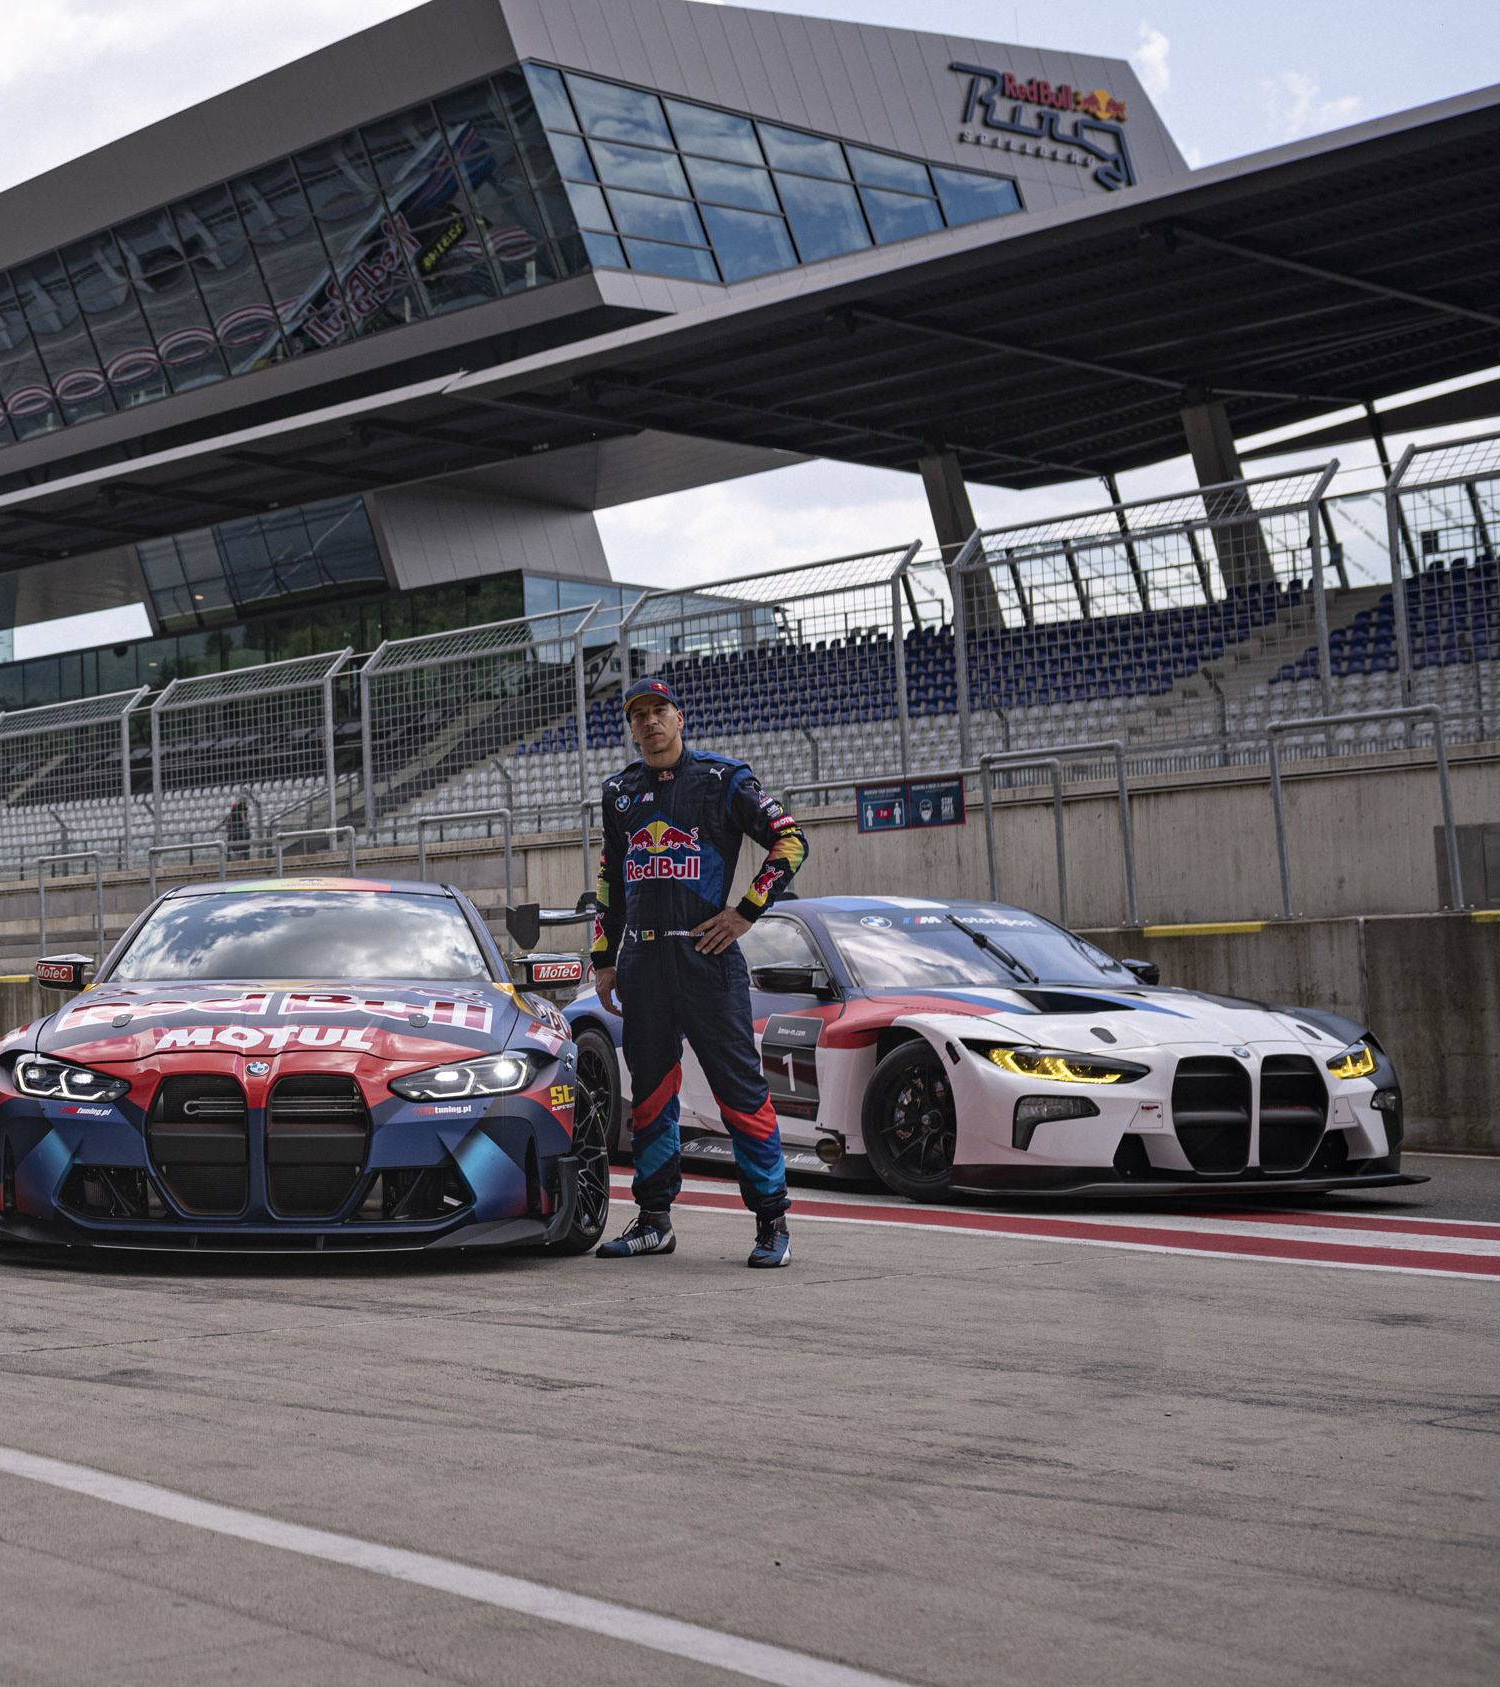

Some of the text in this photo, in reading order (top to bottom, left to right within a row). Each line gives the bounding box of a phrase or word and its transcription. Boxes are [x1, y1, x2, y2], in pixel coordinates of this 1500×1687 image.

[1003, 73, 1073, 110] Red Bull
[627, 856, 700, 882] Red Bull
[945, 916, 1037, 927] otorsport
[37, 965, 68, 979] MoTeC
[539, 965, 578, 979] MoTeC
[57, 993, 269, 1032] Red
[279, 993, 493, 1033] Bull
[156, 1027, 374, 1050] MOTUL
[782, 1053, 796, 1092] 1
